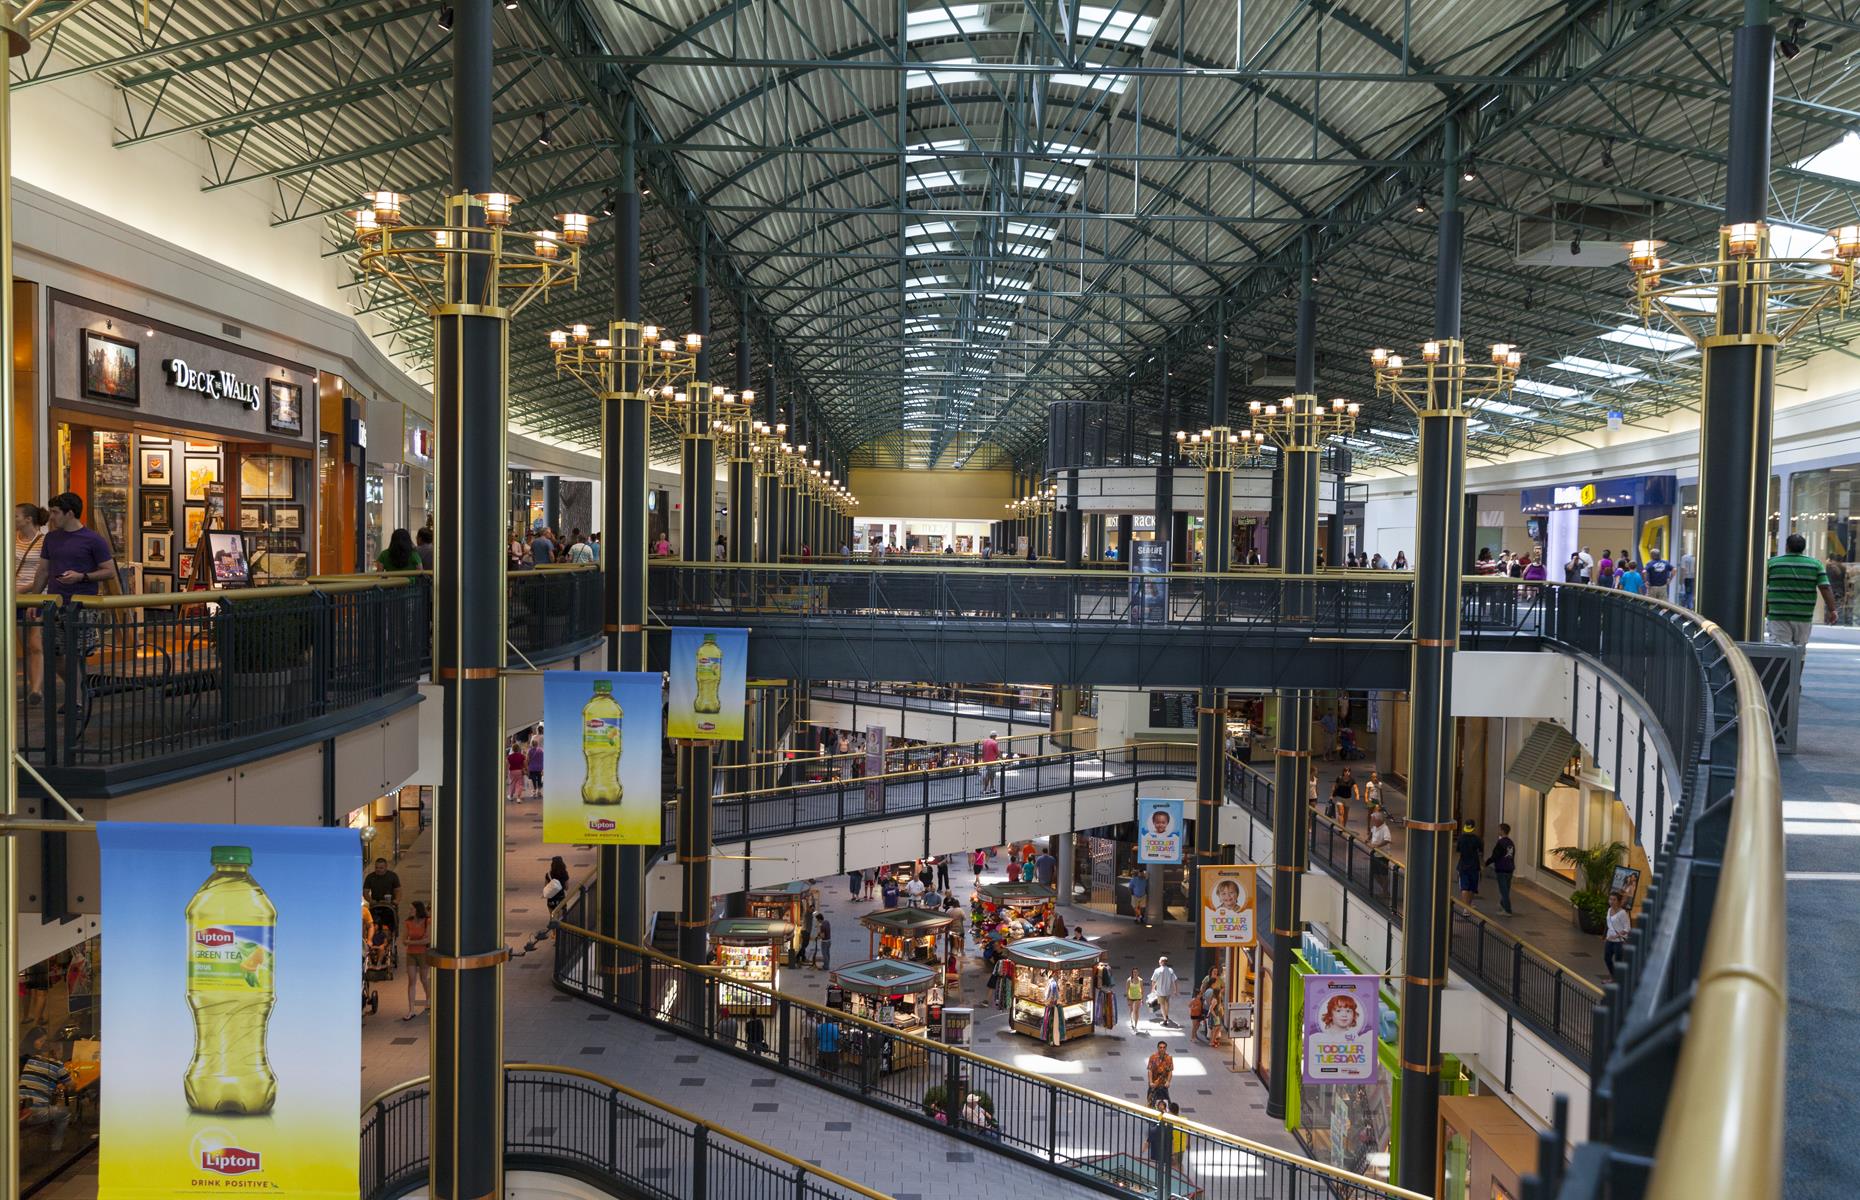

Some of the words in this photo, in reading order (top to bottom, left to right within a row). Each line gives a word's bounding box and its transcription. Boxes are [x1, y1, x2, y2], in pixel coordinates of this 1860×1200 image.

[591, 821, 614, 830] Lipton
[197, 932, 231, 944] Lipton
[195, 950, 221, 960] GREEN
[225, 951, 243, 961] TEA
[1317, 1044, 1364, 1054] TODDLER
[1315, 1054, 1366, 1064] TUESDAYS
[206, 1152, 256, 1169] Lipton
[191, 1179, 221, 1187] DRINK
[225, 1180, 268, 1188] POSITIVE
